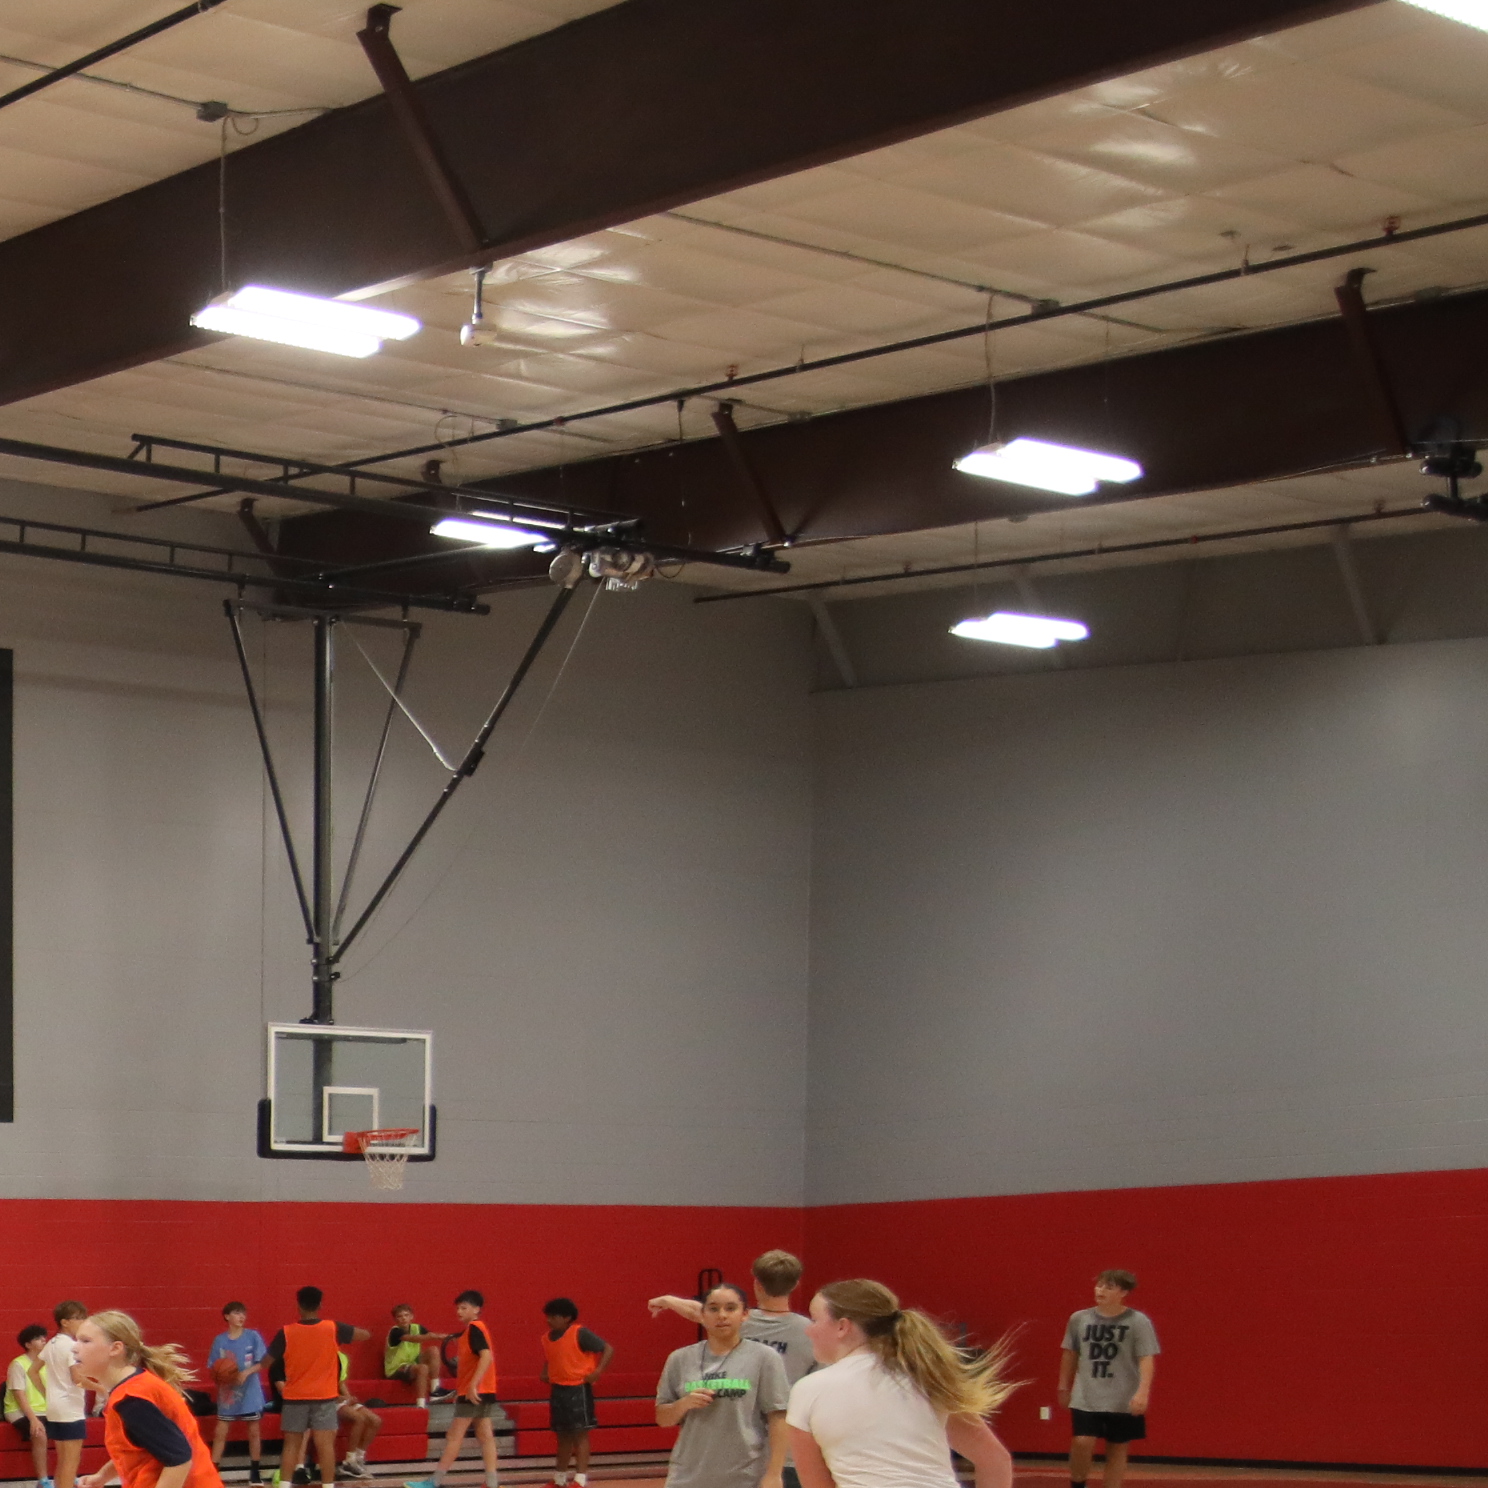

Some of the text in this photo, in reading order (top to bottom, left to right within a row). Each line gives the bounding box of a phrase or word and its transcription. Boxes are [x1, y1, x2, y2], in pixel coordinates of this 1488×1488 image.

[1082, 1324, 1130, 1342] JUST
[1089, 1342, 1118, 1360] DO
[1091, 1360, 1114, 1378] IT.
[716, 1388, 747, 1398] CAMP
